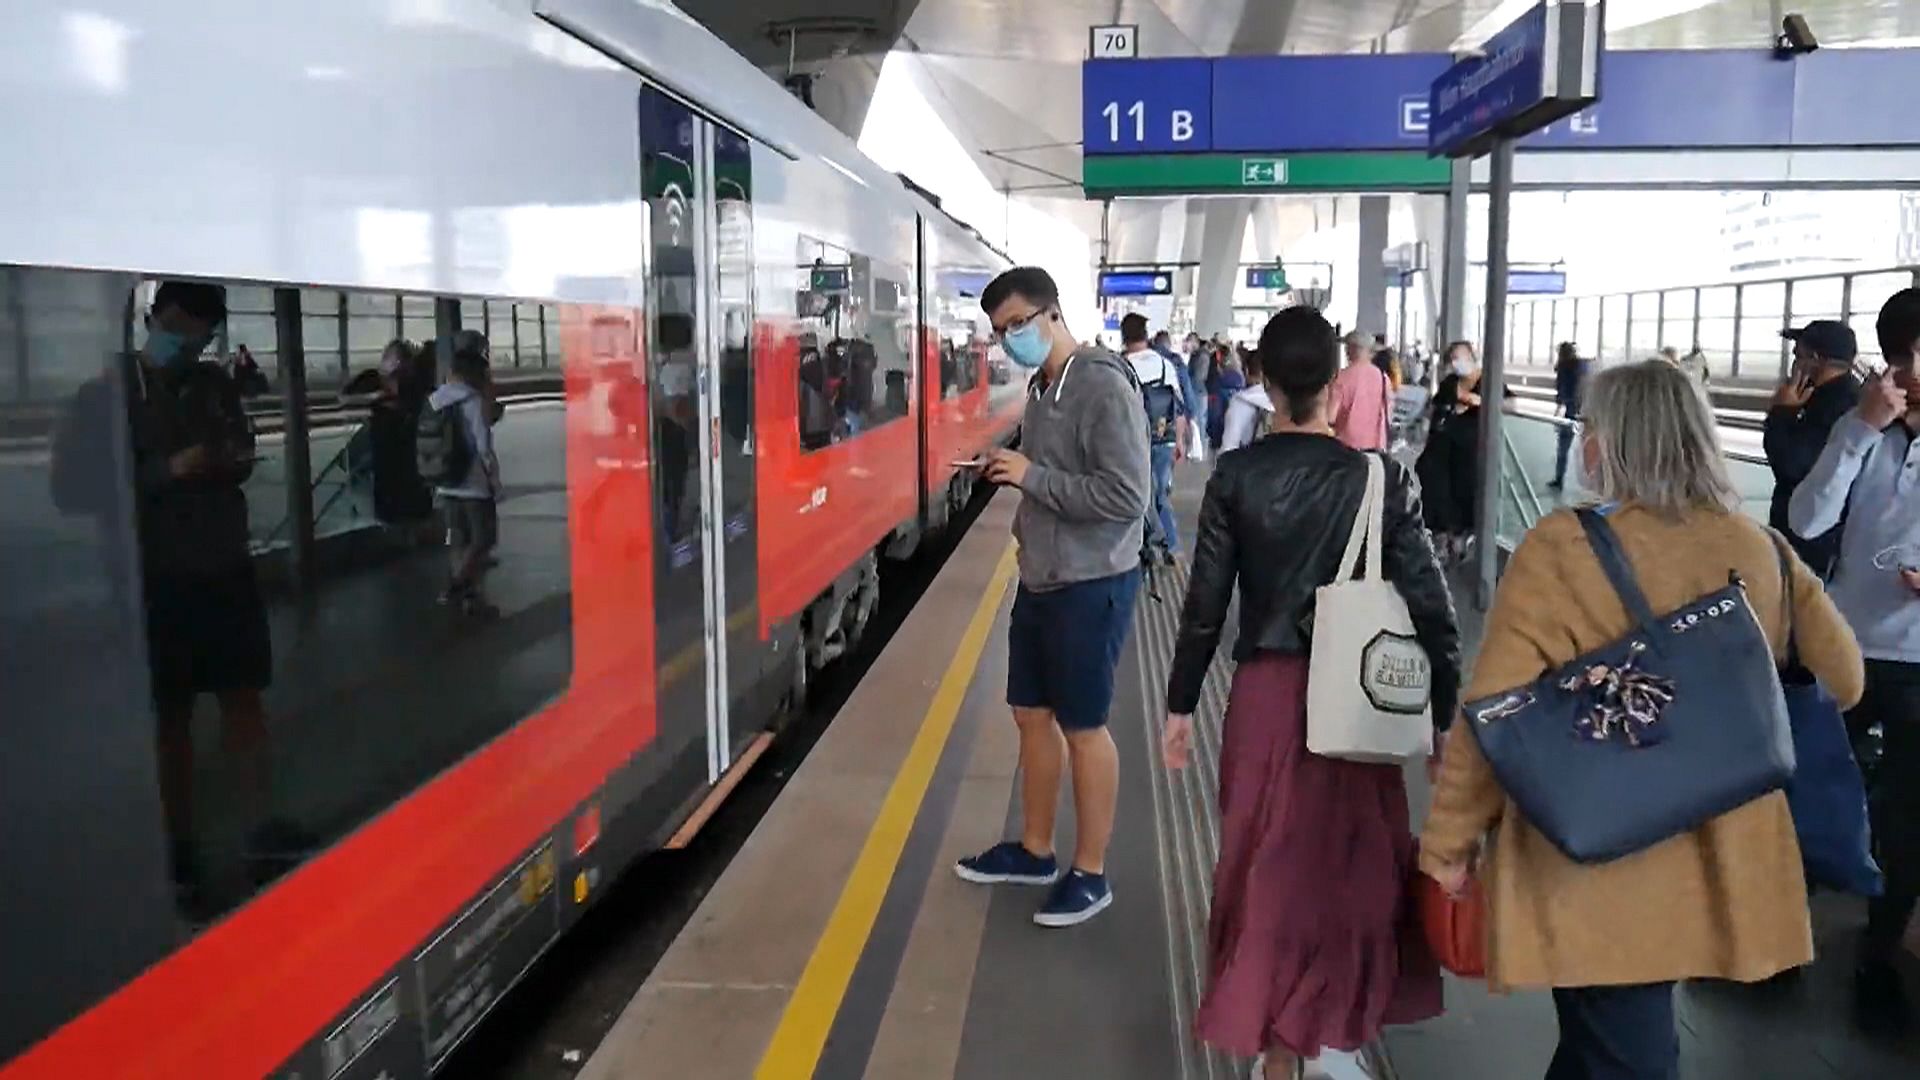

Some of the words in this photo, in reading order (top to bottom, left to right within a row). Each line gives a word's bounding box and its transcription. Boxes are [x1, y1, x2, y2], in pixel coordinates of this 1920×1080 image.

[1104, 34, 1127, 51] 70
[1102, 100, 1144, 142] 11
[1172, 109, 1194, 142] B
